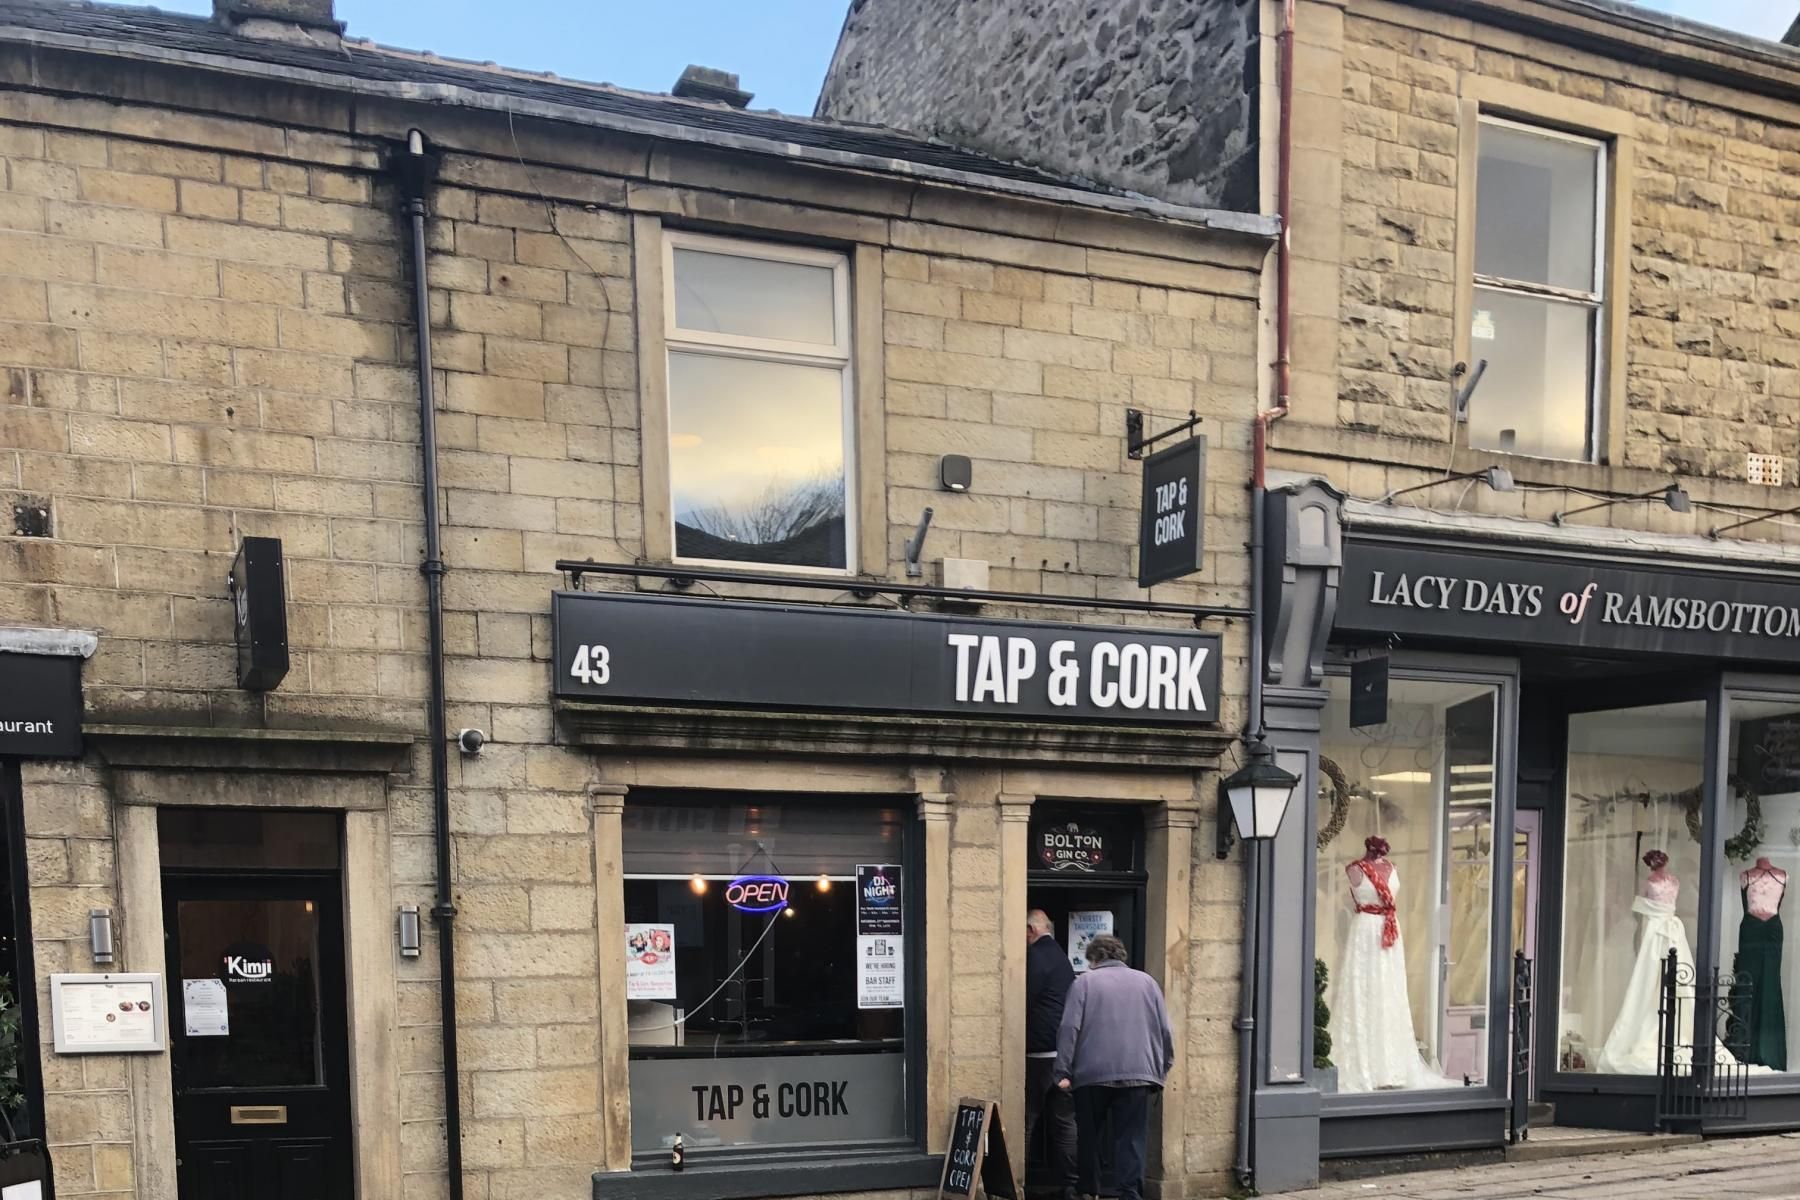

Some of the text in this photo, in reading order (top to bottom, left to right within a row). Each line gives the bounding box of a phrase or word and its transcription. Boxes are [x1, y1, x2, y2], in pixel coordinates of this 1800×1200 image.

[1156, 477, 1188, 513] TAP &
[1155, 510, 1185, 546] CORK
[1370, 571, 1458, 609] LACY
[1463, 579, 1544, 617] DAYS
[1559, 582, 1598, 624] of
[571, 644, 610, 685] 43
[948, 633, 1209, 711] TAP & CORK
[1044, 833, 1103, 849] BOLTON
[1056, 850, 1073, 859] GIN
[873, 875, 885, 886] DJ
[725, 882, 789, 904] OPEN
[863, 884, 896, 898] NIGHT
[865, 976, 896, 985] BAR STAFF
[691, 1080, 849, 1120] TAP & CORK
[961, 1109, 984, 1128] TAP
[953, 1148, 977, 1166] CORK
